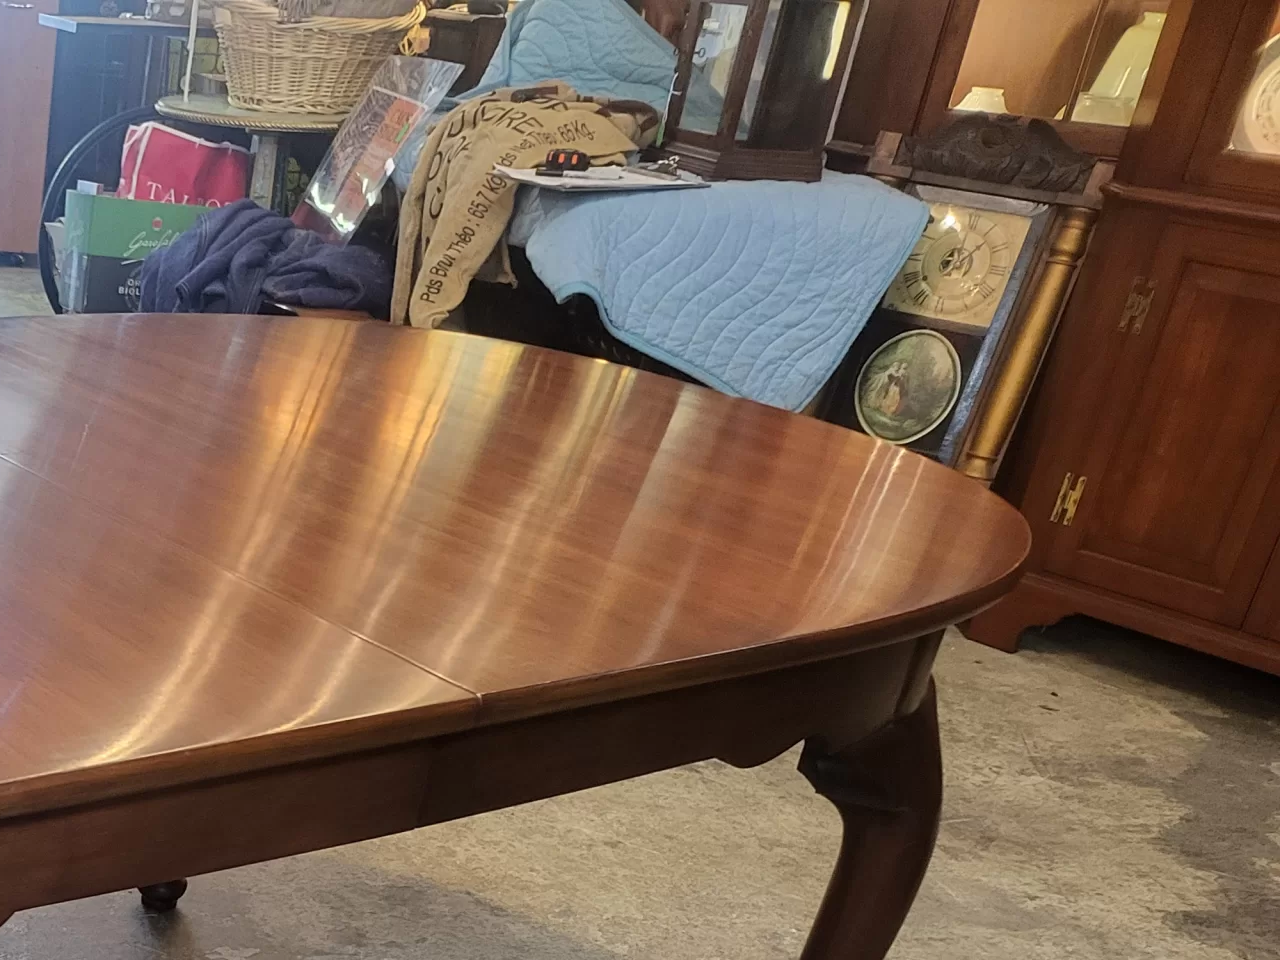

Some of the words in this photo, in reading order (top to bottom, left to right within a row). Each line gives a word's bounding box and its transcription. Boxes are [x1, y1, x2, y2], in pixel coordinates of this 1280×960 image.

[123, 229, 180, 257] Garofal
[429, 249, 456, 279] Brut
[118, 286, 141, 296] BIOL
[420, 279, 443, 304] Pds
